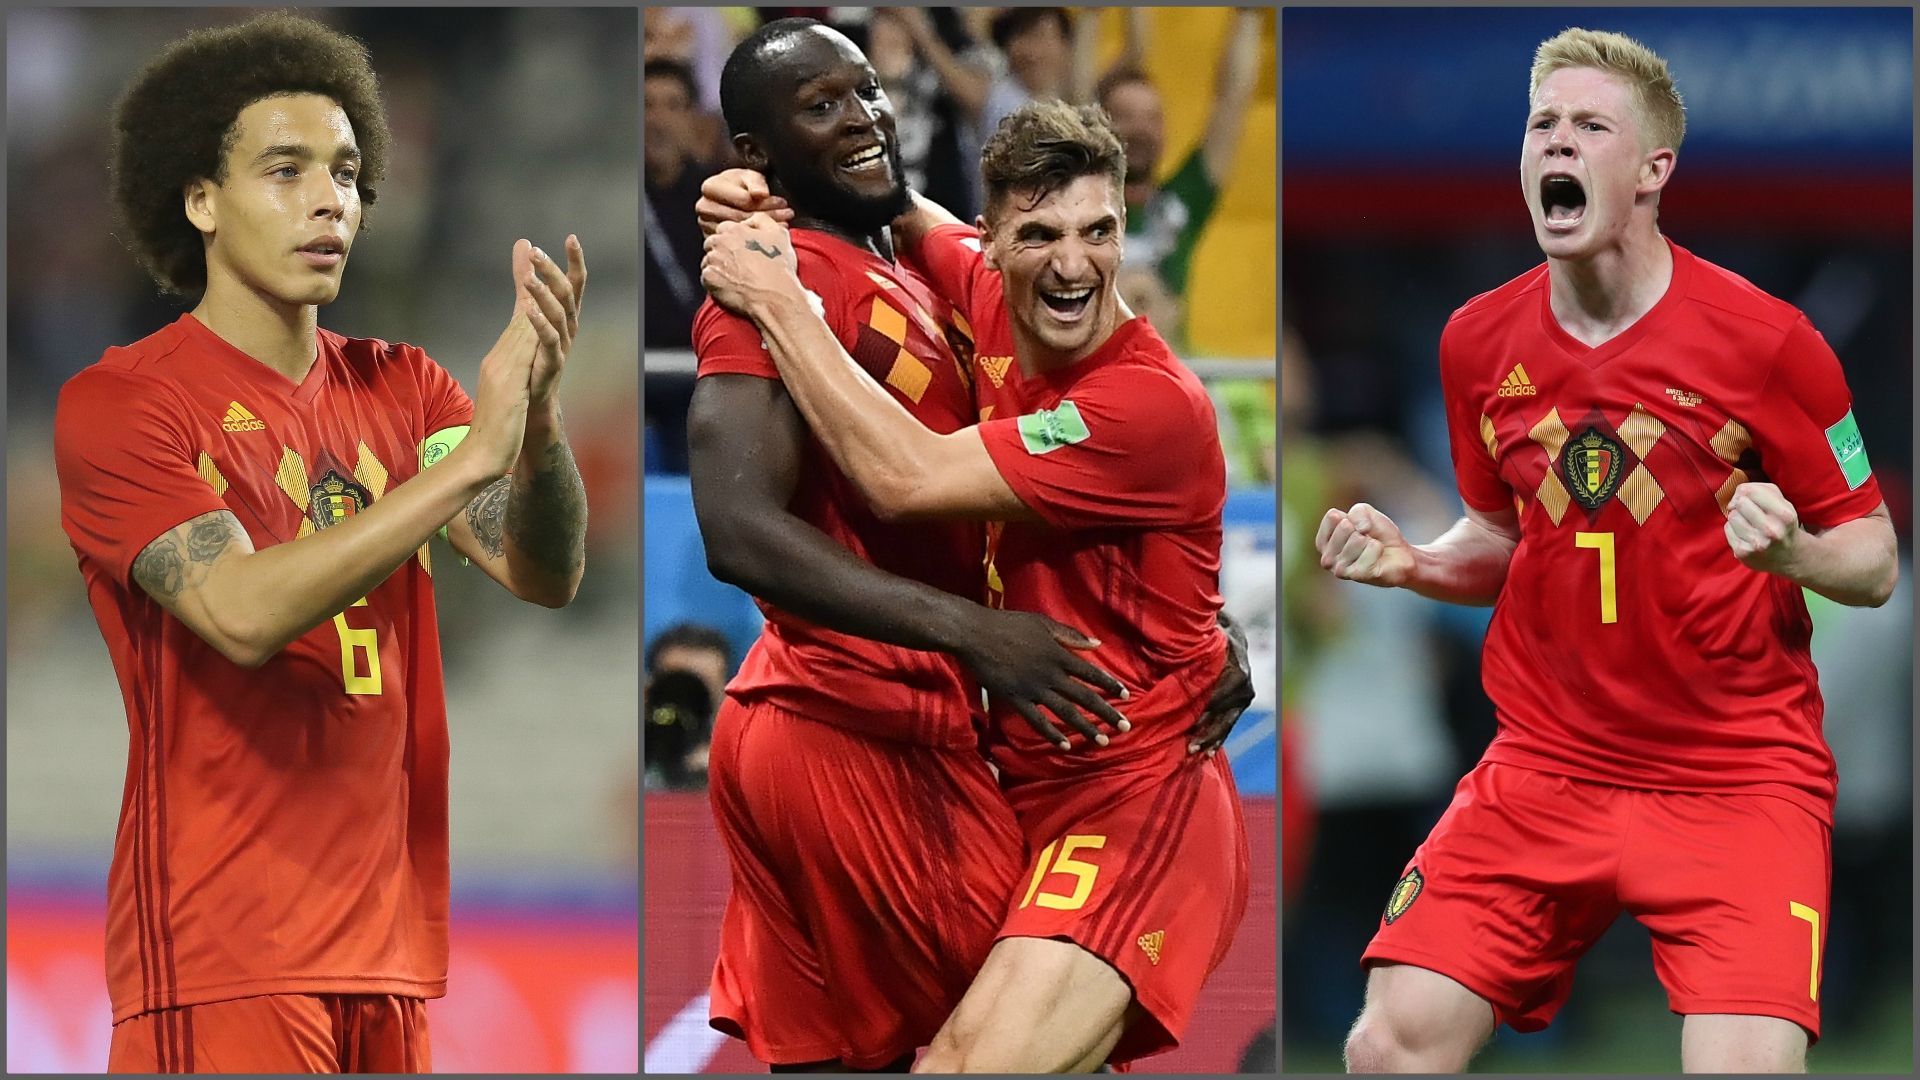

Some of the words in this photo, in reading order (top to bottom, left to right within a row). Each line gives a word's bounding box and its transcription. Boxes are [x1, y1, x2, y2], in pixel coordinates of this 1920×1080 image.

[222, 419, 266, 432] adidas
[1497, 384, 1537, 398] adidas
[1575, 531, 1618, 624] 7
[332, 596, 382, 696] 6
[1018, 835, 1107, 910] 15
[1789, 900, 1820, 1002] 7
